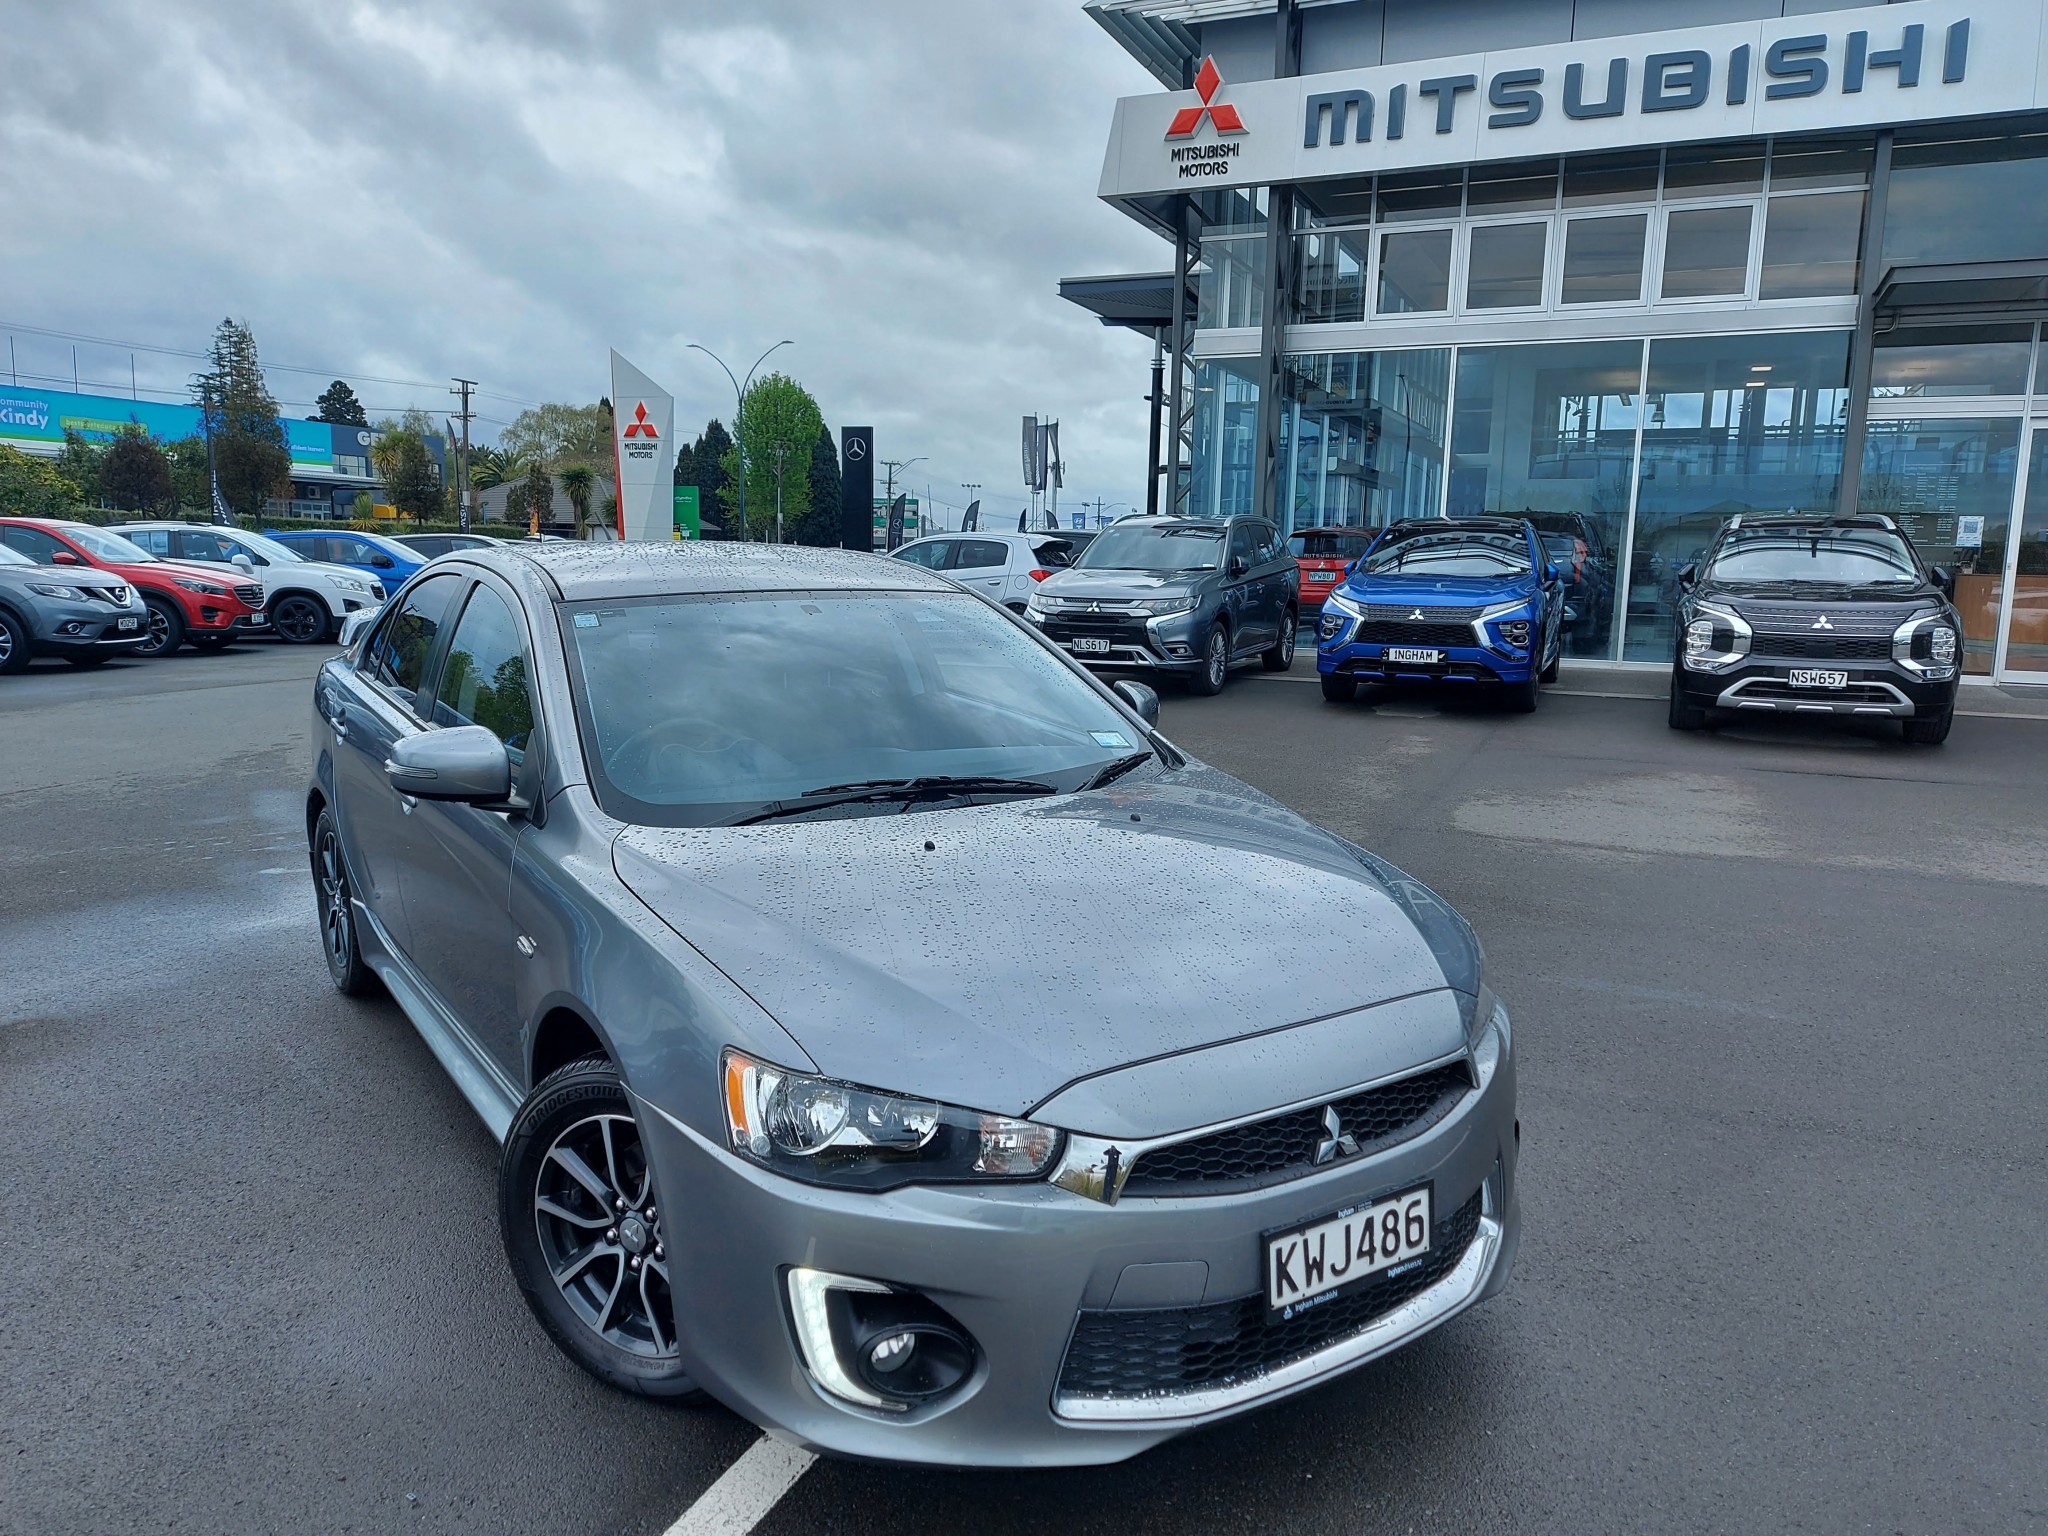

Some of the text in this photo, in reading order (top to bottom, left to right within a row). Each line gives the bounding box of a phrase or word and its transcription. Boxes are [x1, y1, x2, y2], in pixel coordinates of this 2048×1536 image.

[1304, 17, 1971, 149] MITSUBISHI
[1171, 142, 1240, 162] MITSUBISHI
[1178, 161, 1229, 178] MOTORS
[0, 399, 49, 412] ommunity
[624, 443, 658, 451] MITSUBISHI
[628, 451, 653, 459] MOTORS
[1073, 640, 1109, 651] NLS617
[1790, 671, 1846, 686] NSW657
[527, 1085, 623, 1132] BRIDGESTONE
[1275, 1198, 1425, 1300] KWJ486
